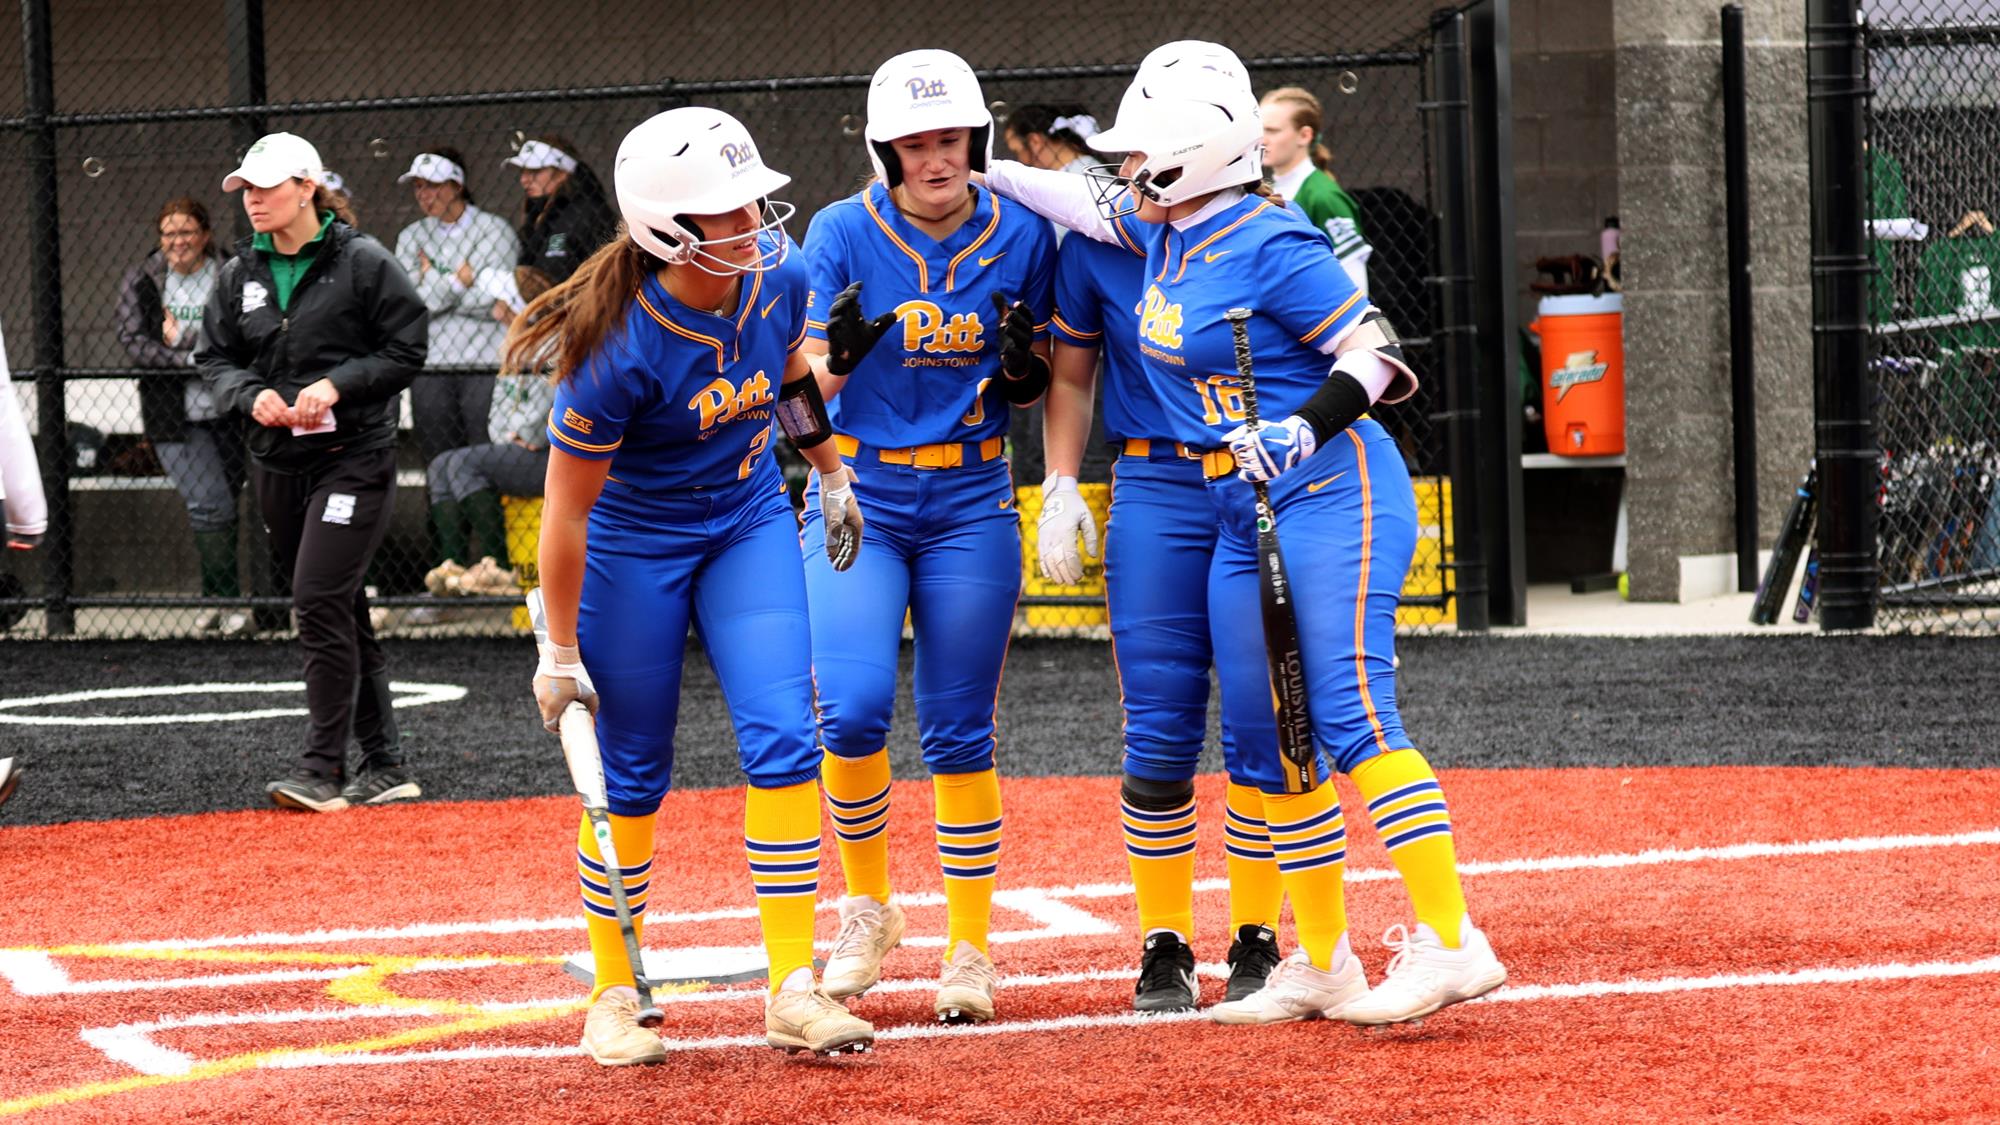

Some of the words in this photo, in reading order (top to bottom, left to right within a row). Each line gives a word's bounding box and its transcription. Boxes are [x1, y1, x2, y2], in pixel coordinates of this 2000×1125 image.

[905, 77, 948, 100] Pitt
[720, 142, 754, 168] Pitt
[893, 300, 985, 354] Pitt
[1135, 284, 1184, 350] Pitt
[902, 357, 980, 368] JOHNSTOWN
[563, 409, 593, 432] PSAC
[688, 370, 774, 430] Pitt
[1190, 374, 1247, 426] 16
[1285, 650, 1311, 760] LOUISVILLE
